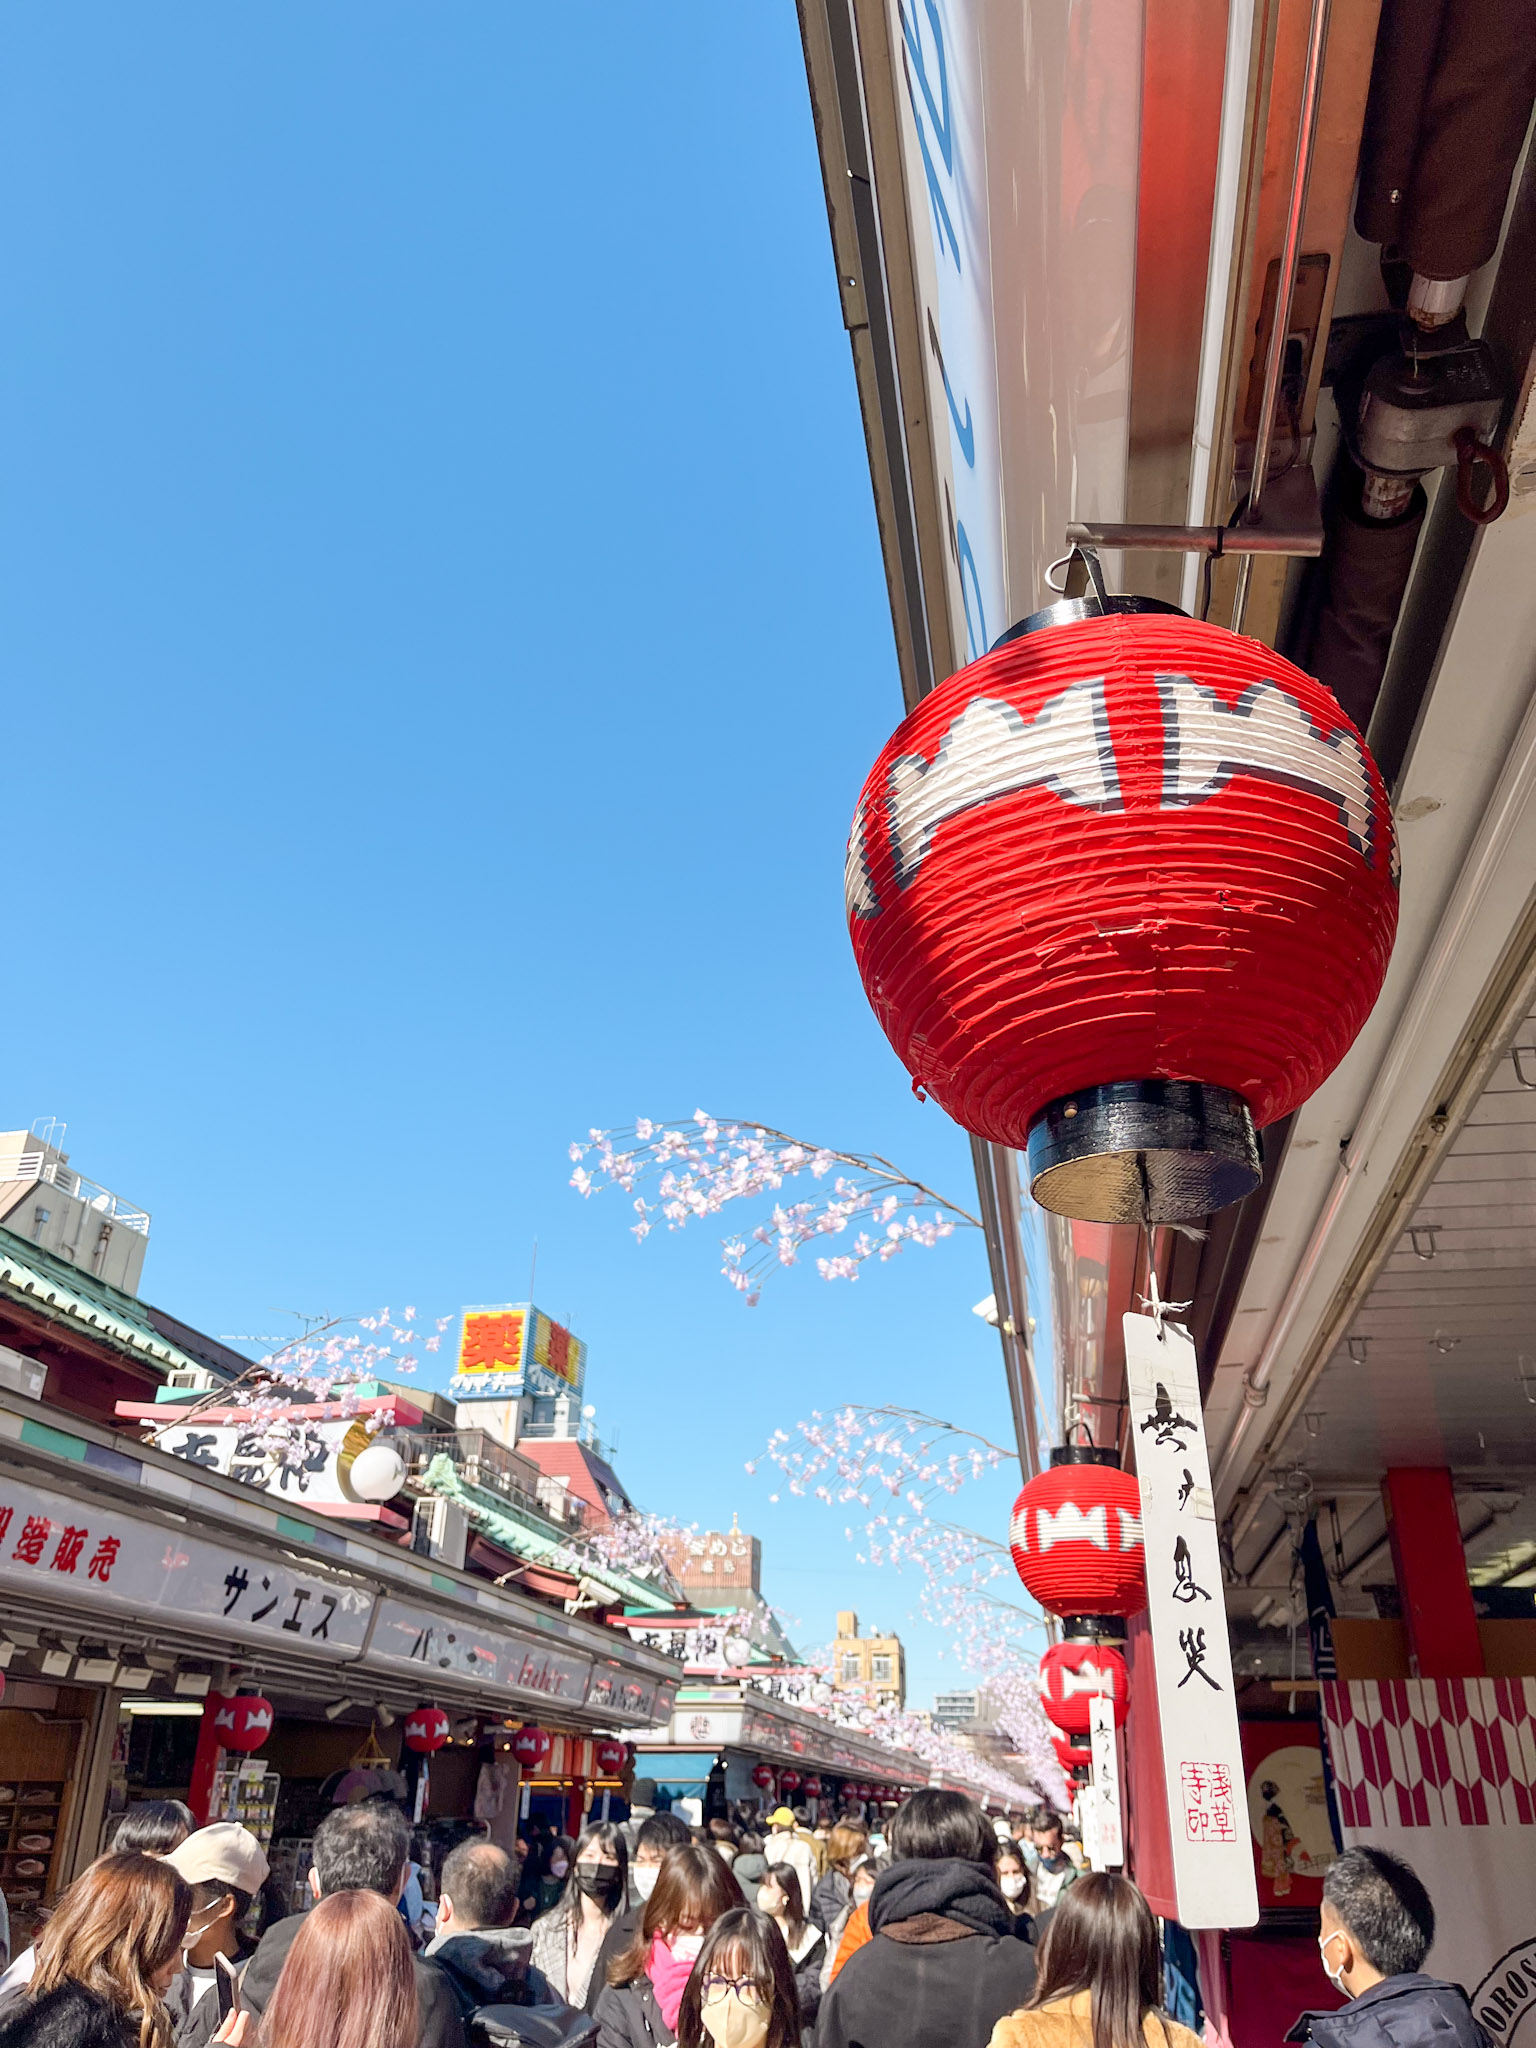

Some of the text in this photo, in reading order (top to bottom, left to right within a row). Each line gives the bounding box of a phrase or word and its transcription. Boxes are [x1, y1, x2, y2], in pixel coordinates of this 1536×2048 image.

[462, 1313, 524, 1369] 薬
[547, 1320, 572, 1378] 薬
[222, 1565, 338, 1641] サンエス
